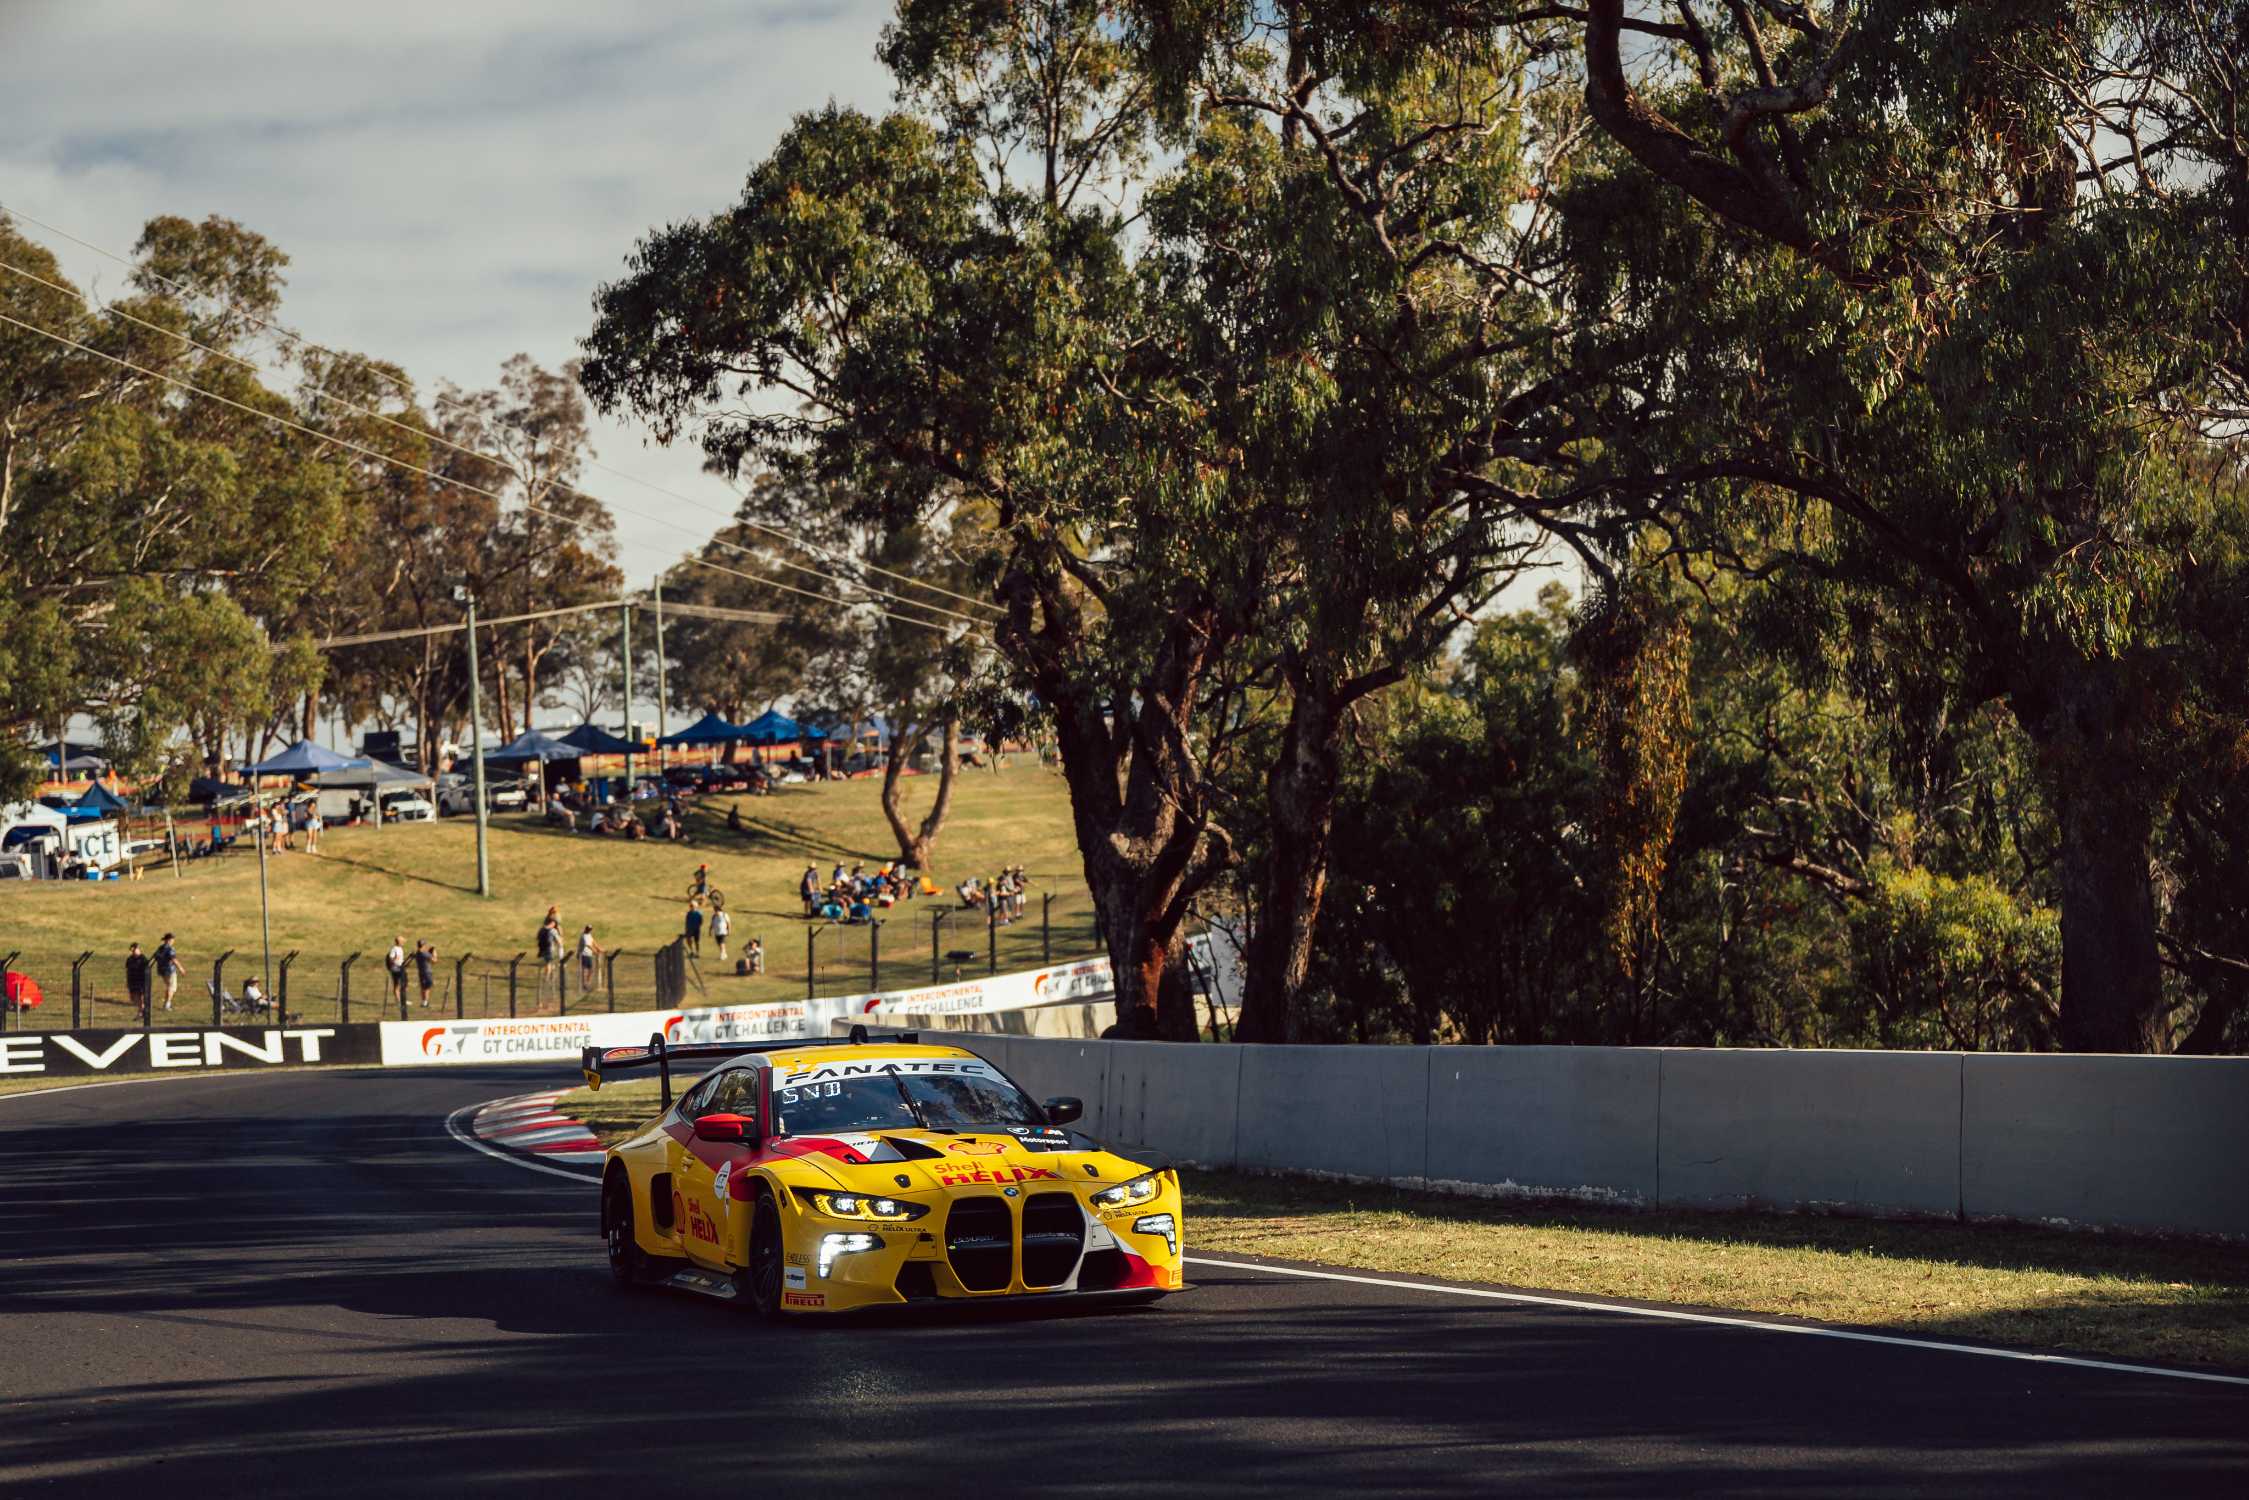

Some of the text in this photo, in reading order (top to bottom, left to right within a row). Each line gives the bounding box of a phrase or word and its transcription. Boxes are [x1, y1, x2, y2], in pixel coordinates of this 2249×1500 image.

[76, 832, 112, 858] ICE
[715, 1007, 804, 1023] INTERCONTINENTAL
[483, 1022, 591, 1037] INTERCONTINENTAL
[715, 1019, 805, 1039] GT CHALLENGE
[0, 1029, 335, 1073] EVENT
[483, 1035, 592, 1054] GT CHALLENGE
[785, 1063, 984, 1084] FANATEC
[934, 1161, 985, 1174] Shell
[942, 1166, 1064, 1186] HELIX
[785, 1292, 825, 1306] PIRELLI
